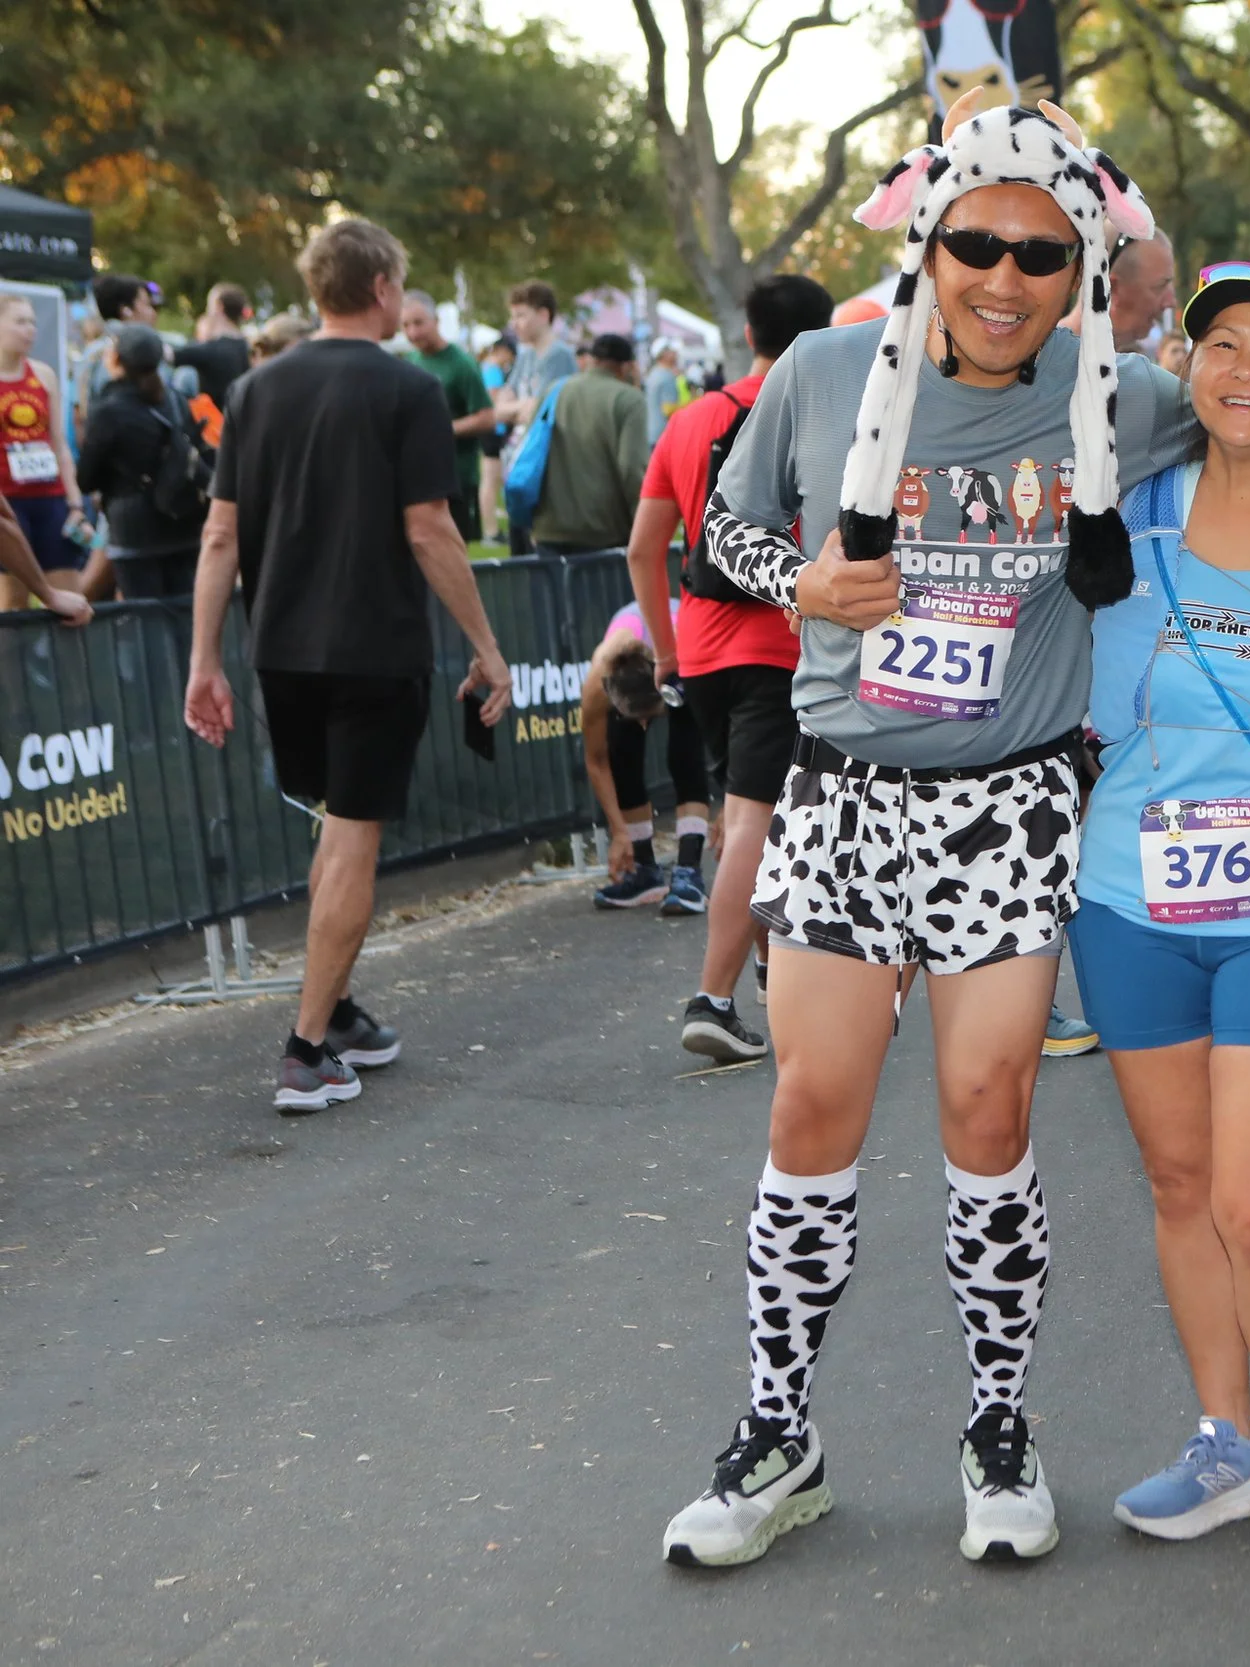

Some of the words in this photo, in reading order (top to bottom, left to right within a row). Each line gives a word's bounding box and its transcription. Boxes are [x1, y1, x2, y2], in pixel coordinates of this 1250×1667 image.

[891, 547, 980, 577] ban
[957, 582, 963, 593] 1
[968, 582, 980, 593] &
[1000, 582, 1029, 596] 2022
[919, 595, 975, 614] Urban
[978, 603, 1014, 618] Cow
[933, 611, 953, 621] Half
[954, 614, 999, 626] Marathon
[878, 630, 995, 688] 2251
[516, 717, 529, 744] A
[529, 714, 565, 741] Race
[3, 808, 43, 843] No
[45, 781, 127, 831] Udder!
[1195, 805, 1250, 819] Urban
[1212, 819, 1231, 827] Half
